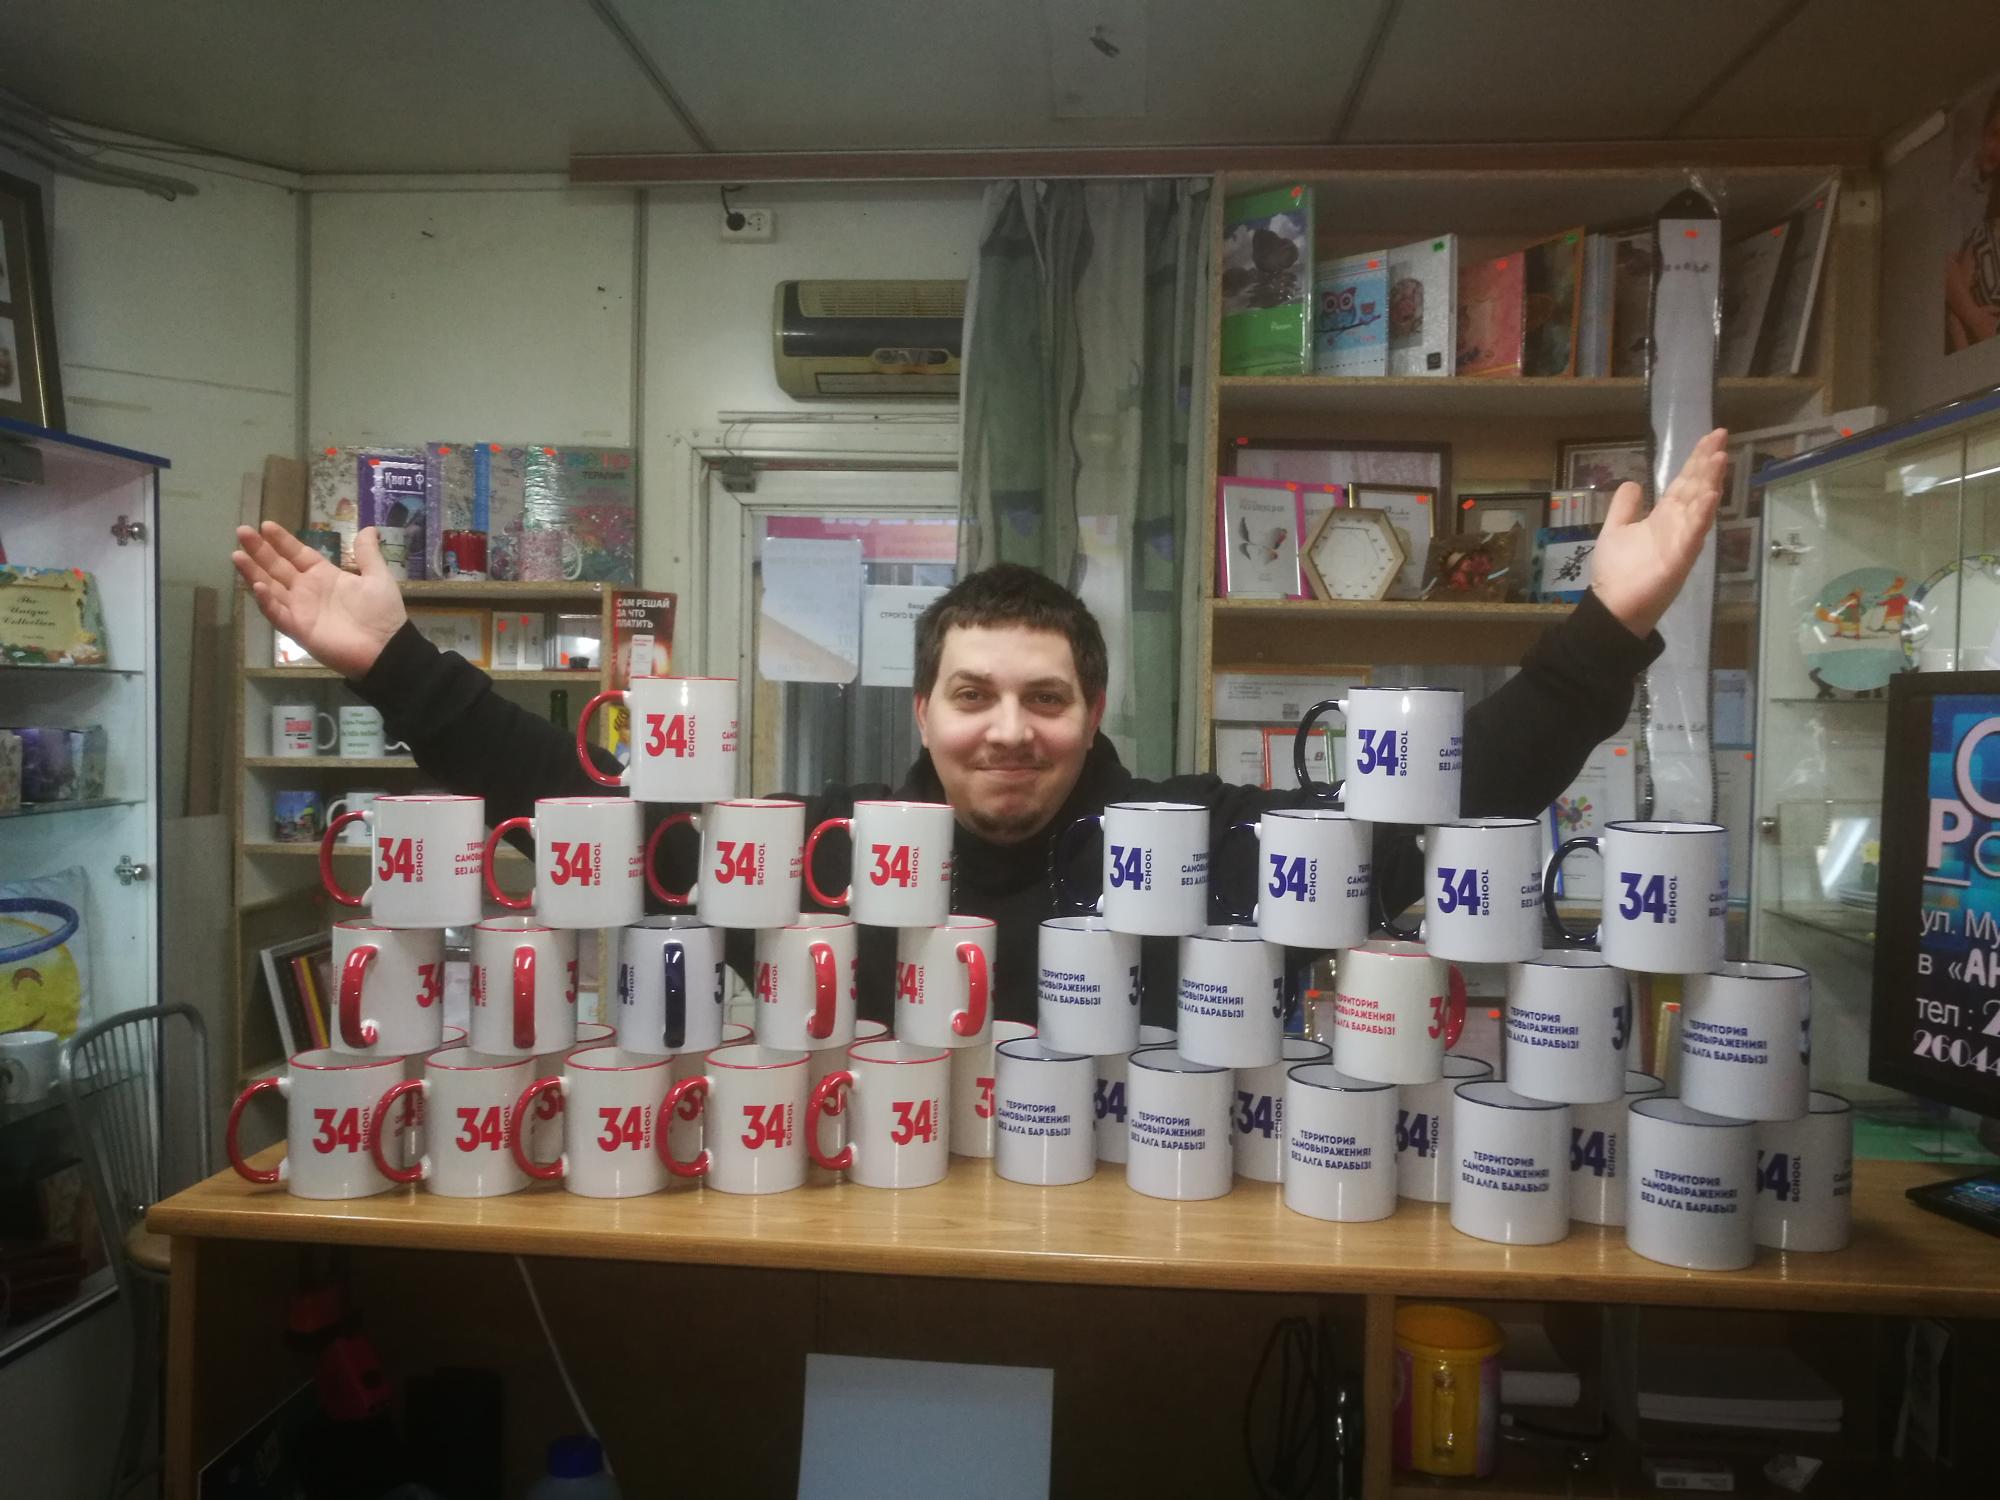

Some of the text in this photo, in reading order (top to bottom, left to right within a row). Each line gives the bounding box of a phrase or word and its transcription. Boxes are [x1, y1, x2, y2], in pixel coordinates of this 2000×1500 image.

[616, 619, 654, 628] ПЛАТИТЬ
[617, 598, 670, 608] САМ РЕШАЙ
[617, 609, 646, 618] ЗА ЧТО
[645, 714, 687, 757] 34
[688, 715, 696, 757] SCHOOL
[1357, 729, 1399, 776] 34
[1400, 730, 1408, 776] SCHOOL
[377, 837, 416, 883] 34
[551, 842, 593, 886] 34
[714, 841, 757, 885] 34
[757, 843, 765, 885] SCHOOL
[869, 844, 911, 887] 34
[911, 847, 919, 887] SCHOOL
[1109, 845, 1144, 890] 34
[1268, 854, 1308, 901] 34
[1309, 858, 1317, 902] SCHOOL
[1437, 867, 1481, 916] 34
[1482, 869, 1490, 915] SCHOOL
[1619, 871, 1667, 923] 34
[1669, 875, 1678, 923] SCHOOL
[1920, 909, 1956, 937] ул.
[1060, 996, 1101, 1005] БАРАБЫЗ!
[1201, 1007, 1244, 1018] БАРАБЫЗ!
[1511, 1006, 1560, 1023] ТЕРРИТОРИЯ
[1352, 1022, 1395, 1035] БАРАБЫЗ!
[1531, 1037, 1579, 1049] БАРАБЫЗ!
[1714, 1051, 1768, 1064] БАРАБЫЗ!
[502, 1104, 511, 1150] SCHOOL
[741, 1104, 786, 1150] 34
[786, 1101, 794, 1146] SCHOOL
[890, 1100, 932, 1145] 34
[932, 1098, 940, 1141] SCHOOL
[998, 1108, 1071, 1124] САМОВЫРАЖЕНИЯ!
[1006, 1100, 1056, 1113] ТЕРРИТОРИЯ
[1138, 1111, 1190, 1127] ТЕРРИТОРИЯ
[1237, 1090, 1274, 1138] 34
[313, 1108, 361, 1154] 34
[456, 1106, 502, 1152] 34
[597, 1106, 643, 1152] 34
[1008, 1124, 1026, 1135] АЛГА
[1028, 1127, 1071, 1137] БАРАБЫЗ!
[1131, 1119, 1205, 1137] САМОВЫРАЖЕНИЯ!
[1141, 1137, 1159, 1148] АЛГА
[1161, 1140, 1205, 1150] БАРАБЫЗ!
[1291, 1137, 1371, 1156] САМОВЫРАЖЕНИЯ!
[1300, 1130, 1356, 1145] ТЕРРИТОРИЯ
[1291, 1151, 1371, 1170] БЕЗ АЛГА БАРАБЫЗ!
[1462, 1159, 1549, 1178] САМОВЫРАЖЕНИЯ!
[1473, 1151, 1534, 1167] ТЕРРИТОРИЯ
[1608, 1133, 1616, 1178] SCHOOL
[1462, 1172, 1549, 1192] БЕЗ АЛГА БАРАБЫЗ!
[1641, 1177, 1737, 1199] САМОВЫРАЖЕНИЯ!
[1654, 1168, 1720, 1186] ТЕРРИТОРИЯ
[1792, 1157, 1801, 1202] SCHOOL
[1641, 1191, 1737, 1214] БЕЗ АЛГА БАРАБЫЗ!
